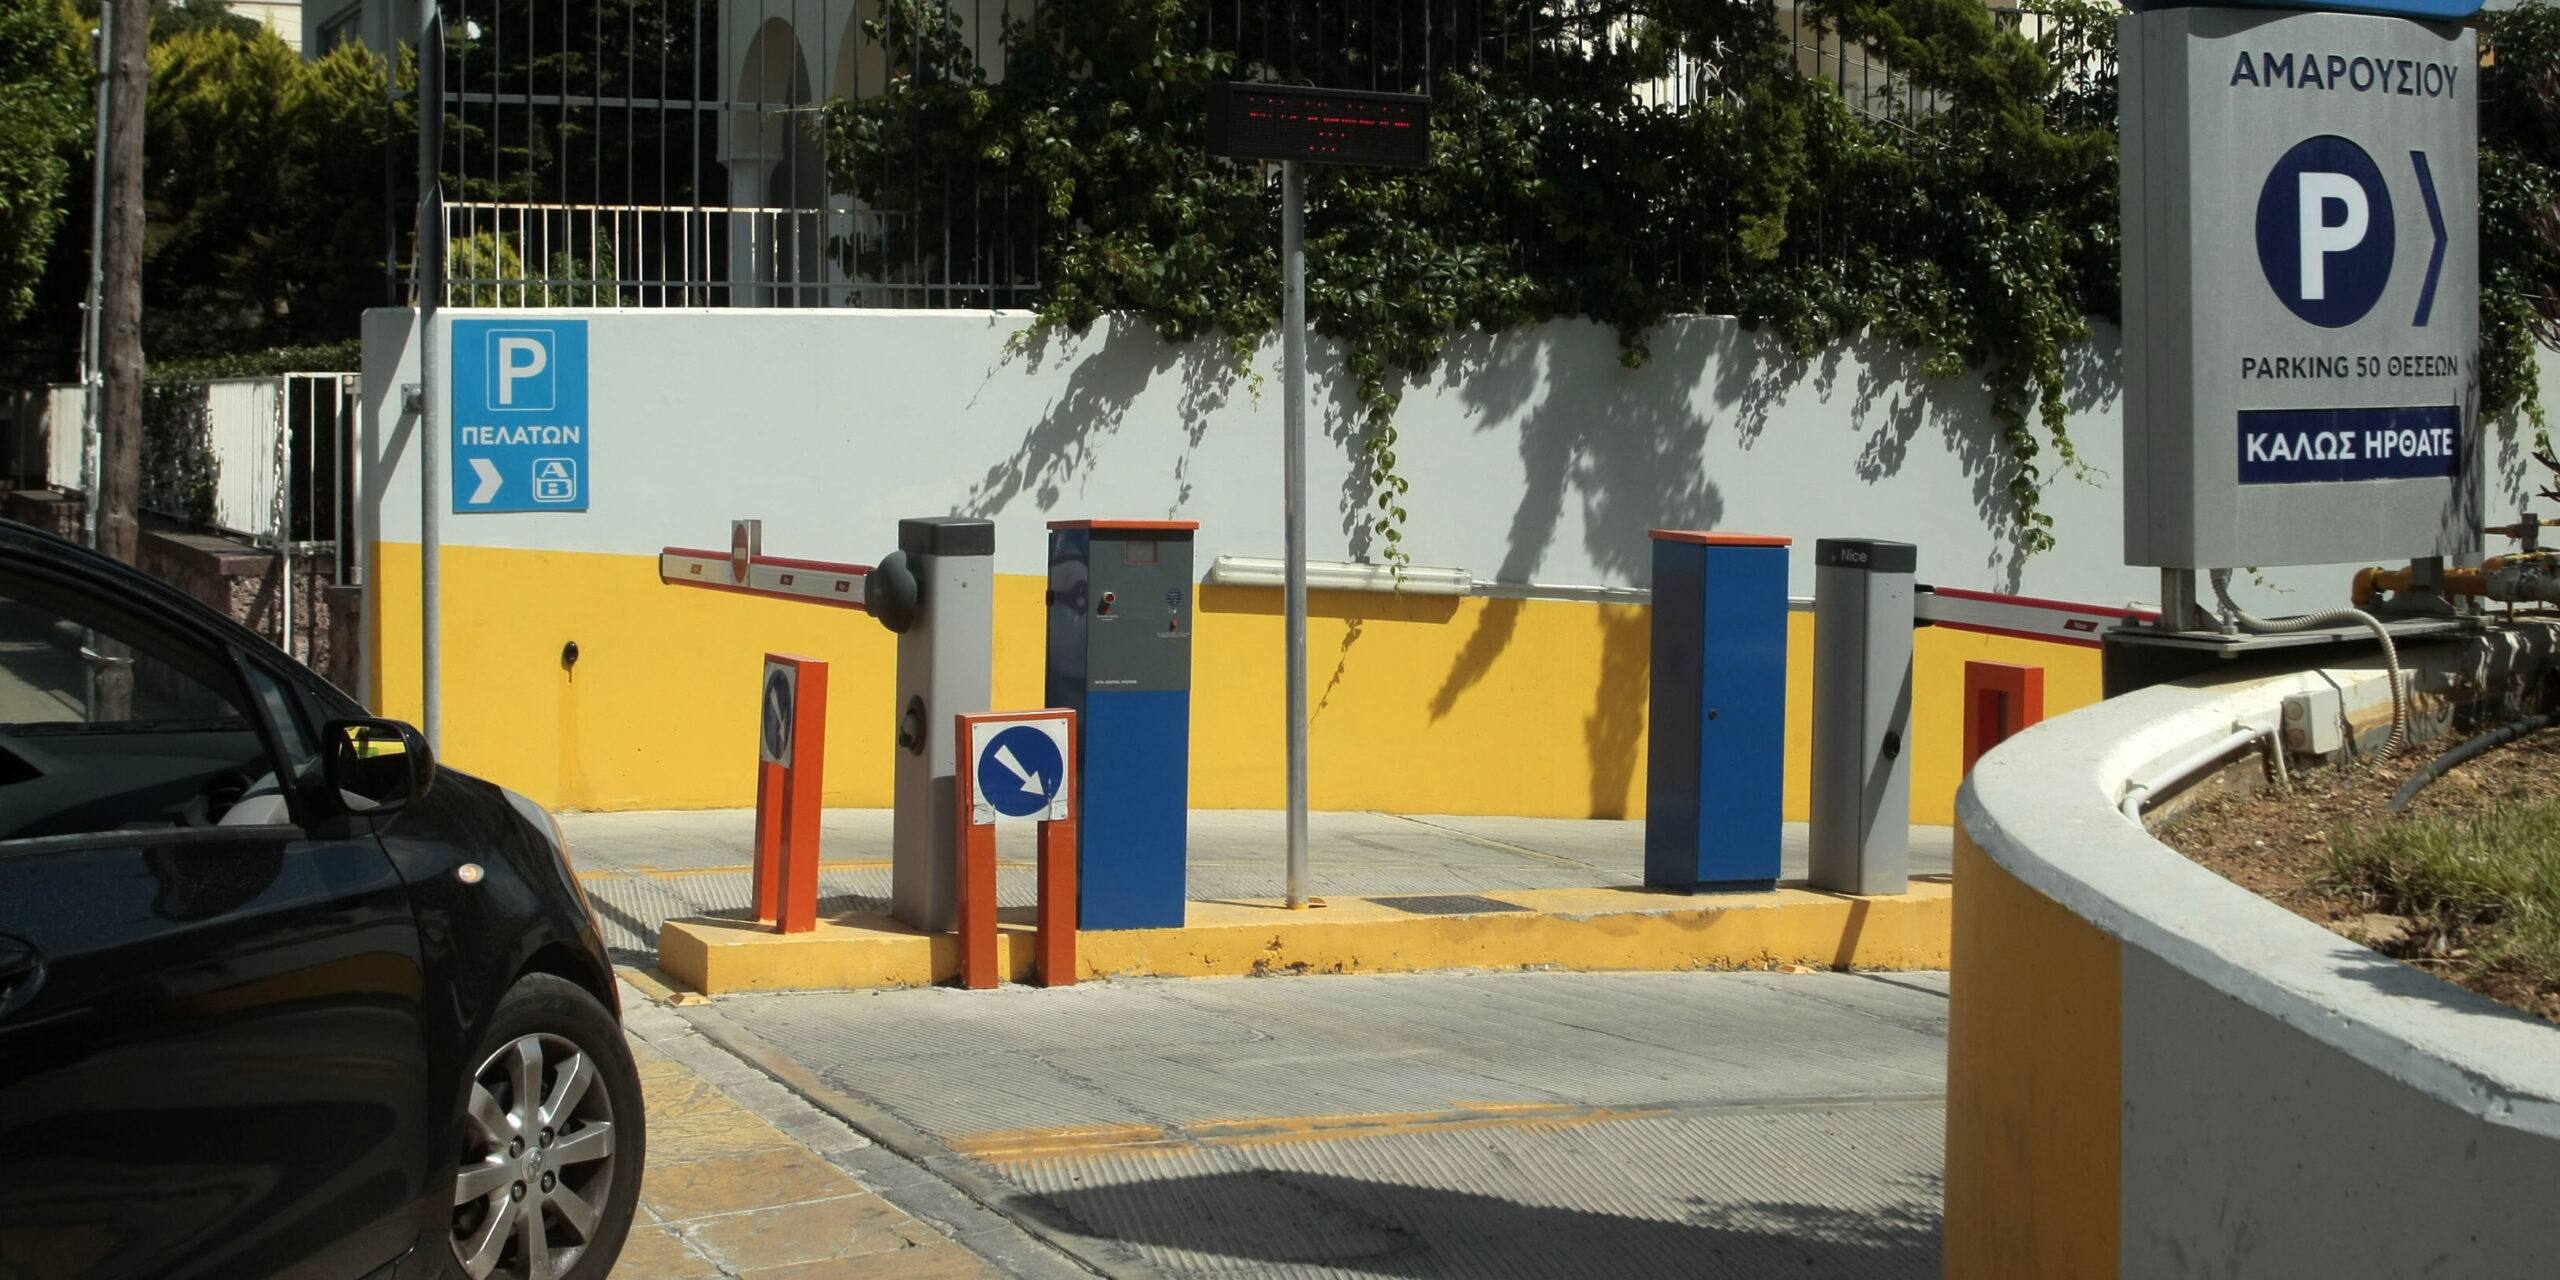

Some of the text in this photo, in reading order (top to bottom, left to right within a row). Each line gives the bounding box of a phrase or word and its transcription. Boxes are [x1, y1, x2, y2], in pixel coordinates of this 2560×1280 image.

[2230, 50, 2458, 99] ΑΜΑΡΟΥΣΙΟΥ
[2298, 171, 2370, 301] P
[498, 337, 548, 405] P
[2241, 355, 2458, 380] PARKING 50 ΘΕΣΕΩΝ
[461, 425, 581, 445] ΠΕΛΑΤΩΝ
[2247, 428, 2453, 462] ΚΑΛΩΣ ΗΡΘΑΤΕ
[1840, 549, 1868, 563] Nice
